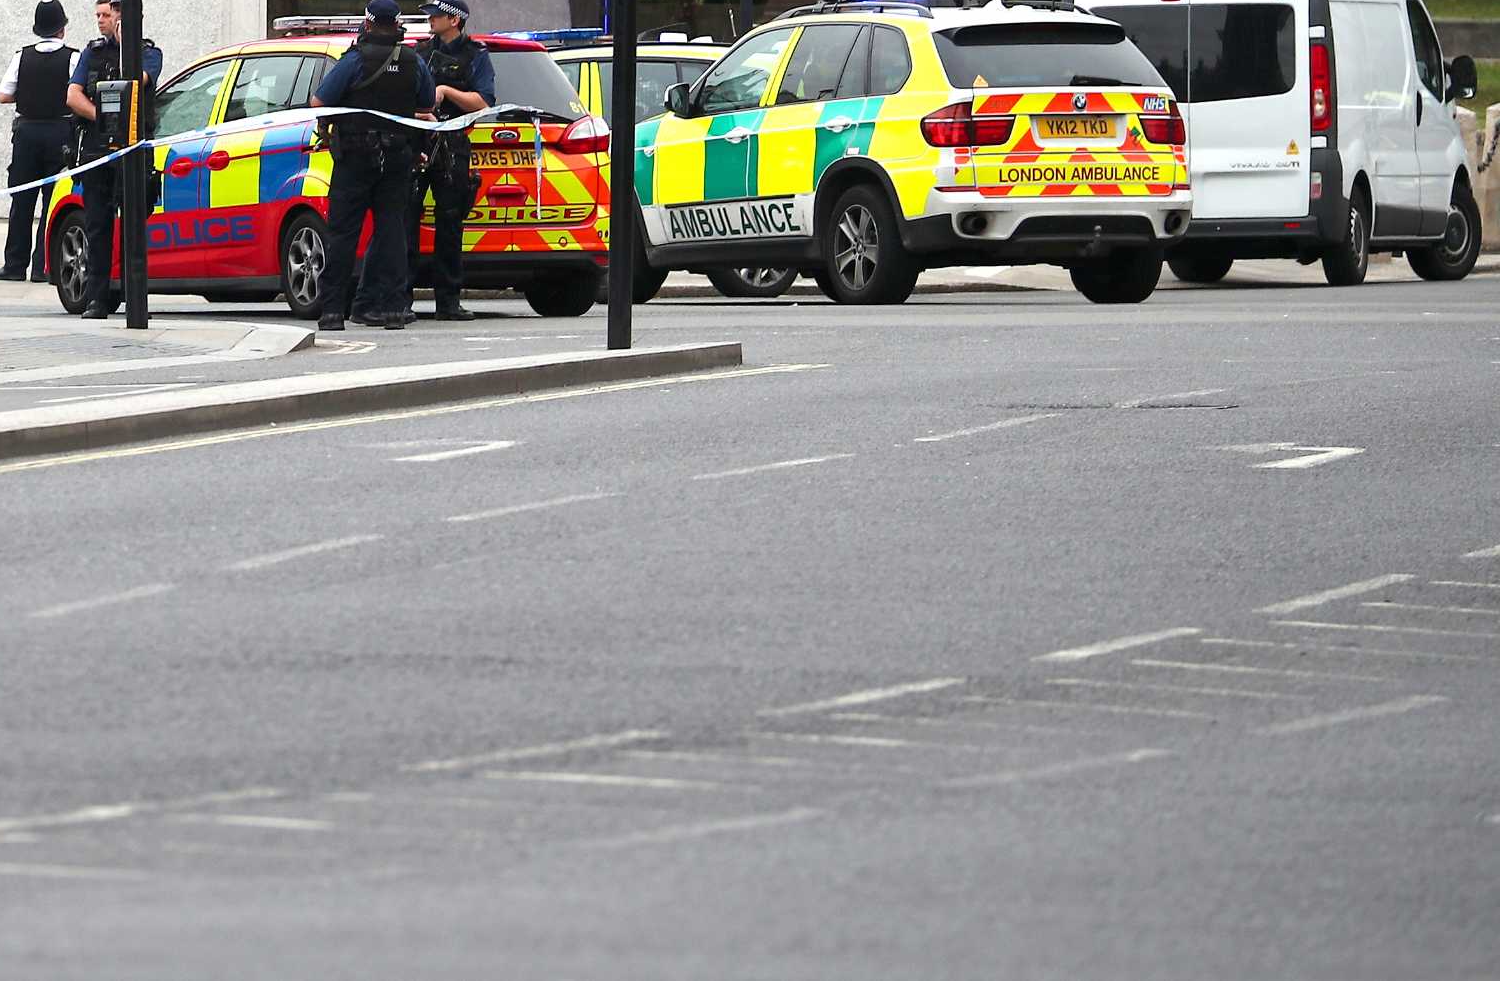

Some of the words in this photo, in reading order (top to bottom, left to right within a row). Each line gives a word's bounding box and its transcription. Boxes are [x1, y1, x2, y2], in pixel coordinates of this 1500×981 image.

[1143, 97, 1166, 111] NHS
[1046, 120, 1077, 136] YK12
[1081, 120, 1108, 136] TKD
[471, 151, 507, 167] BX65
[999, 167, 1066, 183] LONDON
[1070, 166, 1160, 182] AMBULANCE
[467, 207, 586, 220] OLICE
[669, 203, 800, 239] AMBULANCE
[146, 215, 256, 249] OLICE
